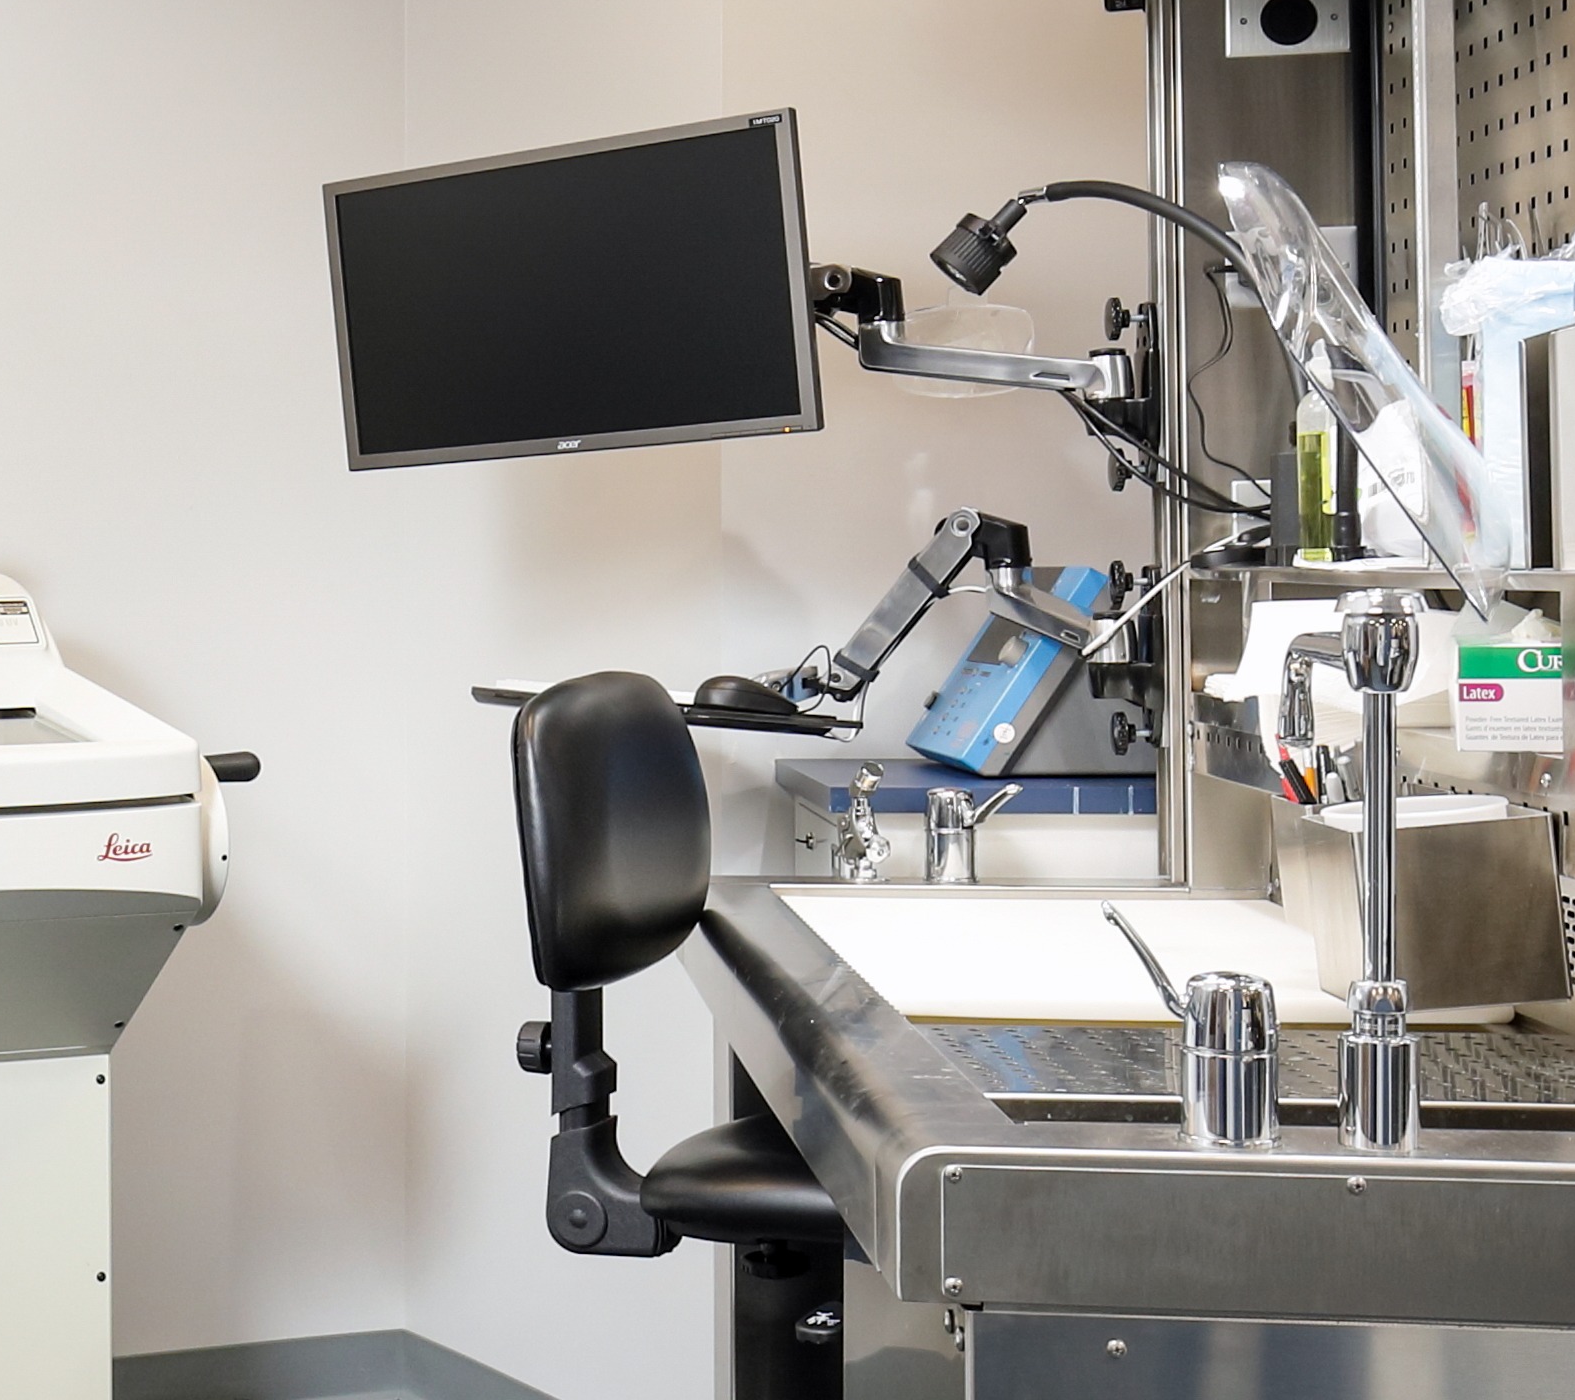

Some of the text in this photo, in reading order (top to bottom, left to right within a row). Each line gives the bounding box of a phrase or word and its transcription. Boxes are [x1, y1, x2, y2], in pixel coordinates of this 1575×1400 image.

[557, 439, 581, 450] acer
[1463, 685, 1496, 700] Latex
[96, 832, 153, 862] Leica
